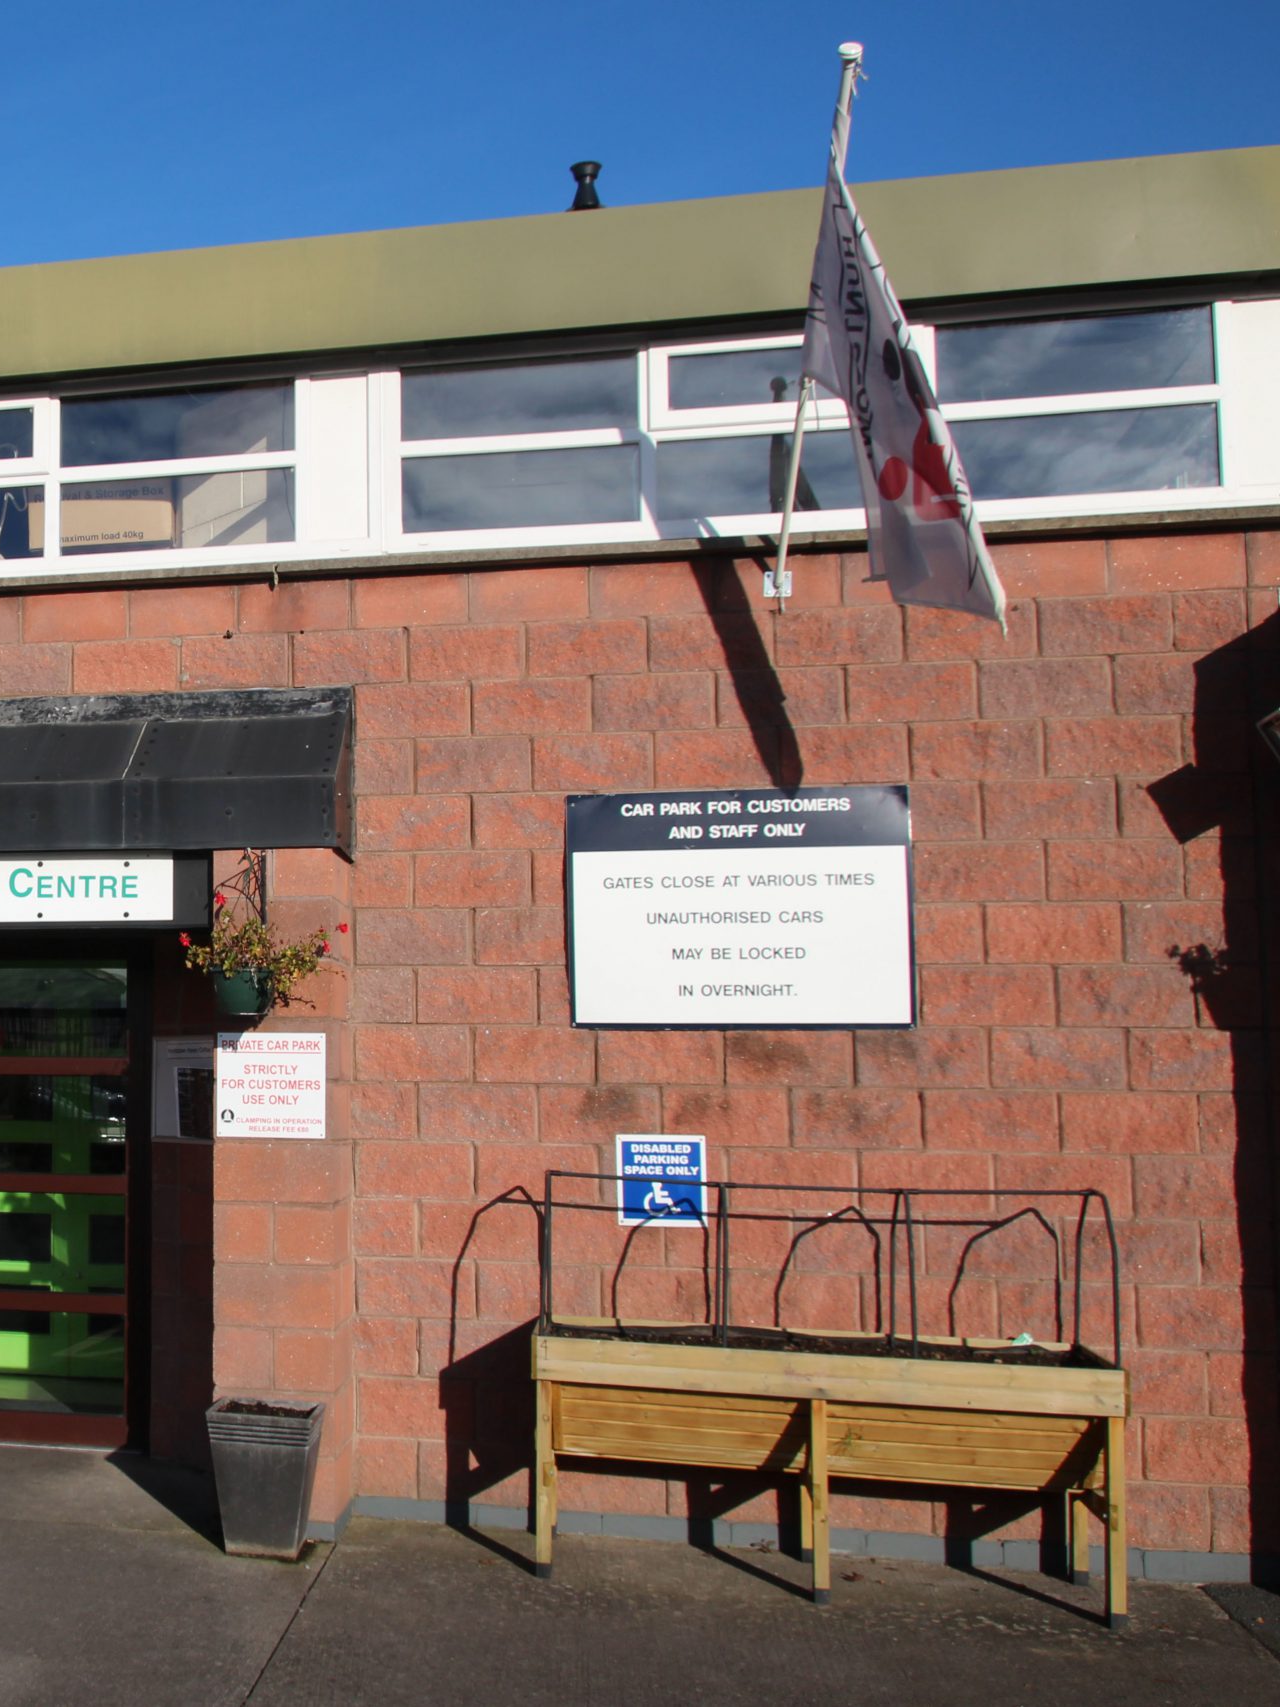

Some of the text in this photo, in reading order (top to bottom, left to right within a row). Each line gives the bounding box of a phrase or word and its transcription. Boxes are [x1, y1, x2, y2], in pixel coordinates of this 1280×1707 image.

[96, 487, 139, 499] Storage
[142, 486, 165, 496] Box
[101, 532, 120, 540] load
[122, 531, 144, 540] 40kg
[620, 798, 851, 817] CAR PARK FOR CUSTOMERS
[669, 822, 806, 840] AND STAFF ONLY
[9, 868, 139, 898] CENTRE
[603, 873, 875, 890] GATES CLOSE AT VARIOUS TIMES
[646, 911, 824, 925] UNAUTHORISED CARS
[672, 948, 806, 960] MAY BE LOCKED
[678, 984, 798, 997] IN OVERNIGHT.
[221, 1040, 263, 1051] PRIVATE
[267, 1040, 289, 1051] CAR
[292, 1040, 320, 1051] PARK
[244, 1064, 298, 1075] STRICTLY
[221, 1079, 321, 1090] FOR CUSTOMERS
[242, 1095, 300, 1105] USE ONLY
[630, 1144, 692, 1154] DISABLED
[634, 1155, 689, 1164] PARKING
[624, 1165, 700, 1176] SPACE ONLY
